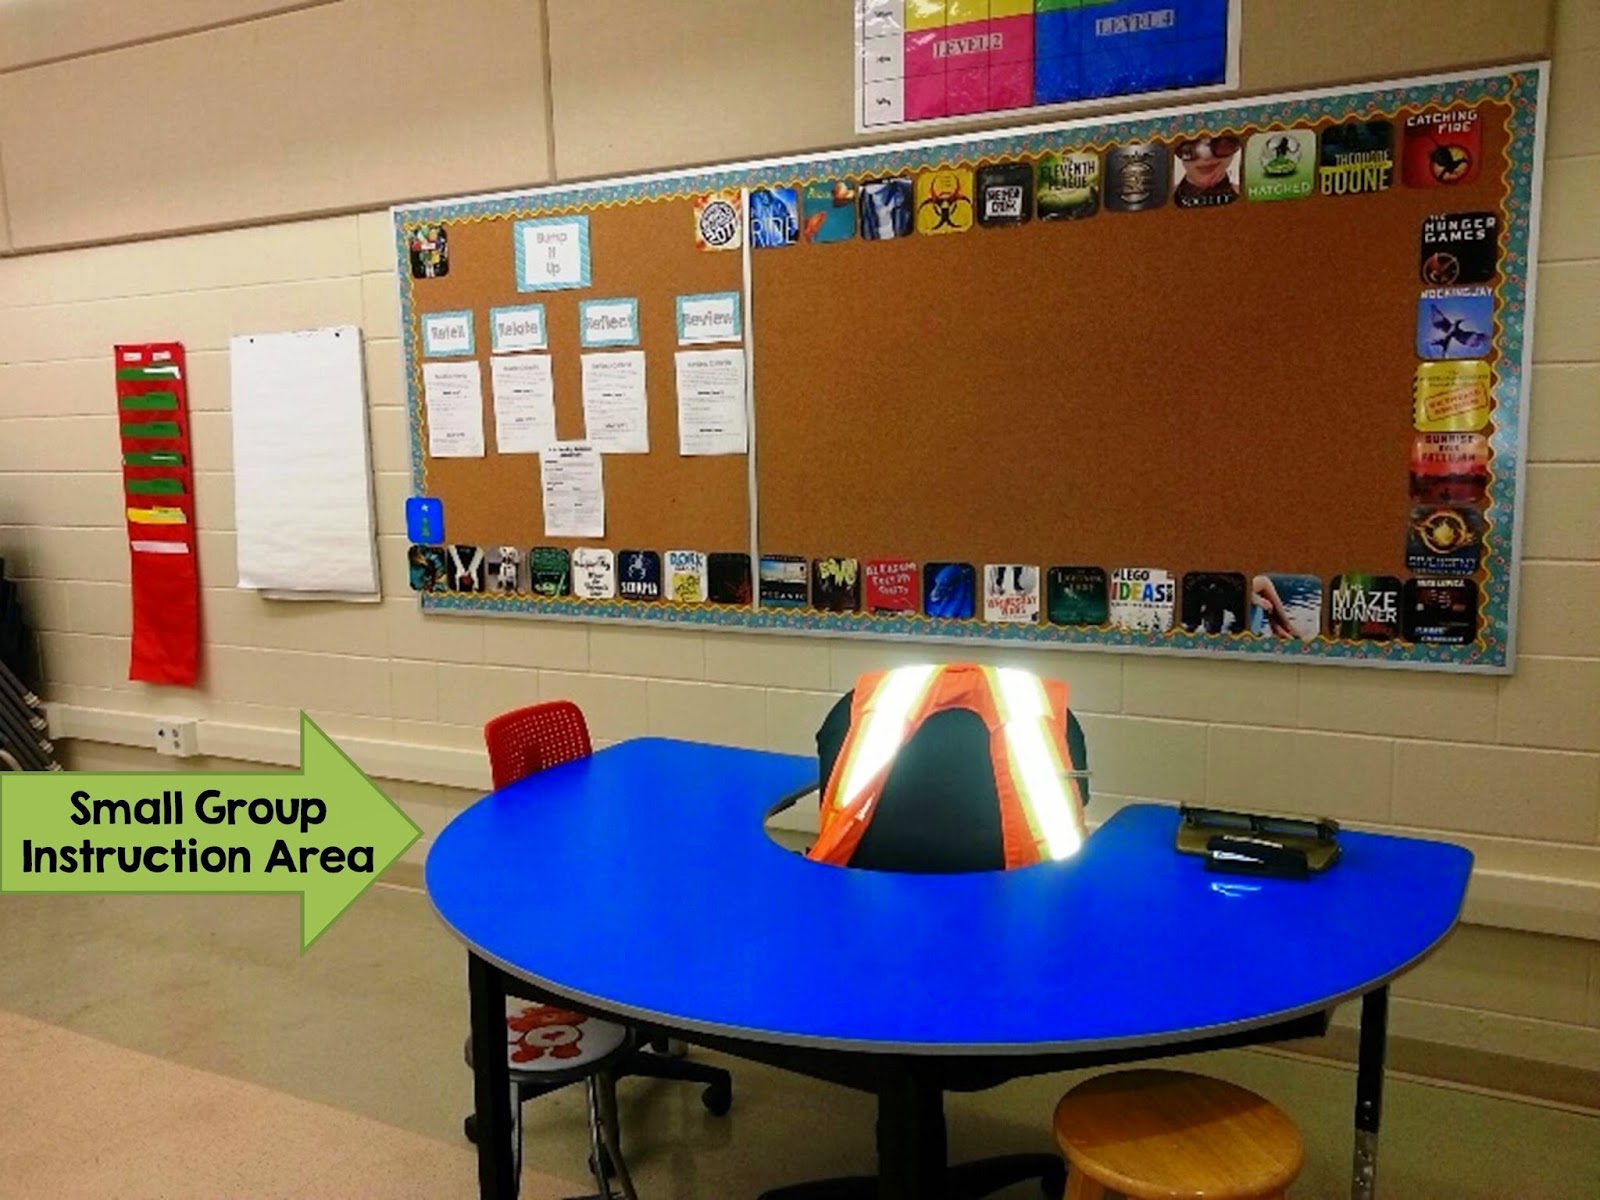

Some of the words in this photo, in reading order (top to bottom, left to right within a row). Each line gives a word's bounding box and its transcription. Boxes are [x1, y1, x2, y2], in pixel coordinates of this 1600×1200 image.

[1407, 110, 1477, 127] CATCHING
[1438, 121, 1471, 134] FIRE
[1320, 167, 1389, 195] BOONE
[1425, 217, 1496, 232] HUNGER
[1425, 229, 1485, 243] GAMES
[546, 262, 561, 277] Up
[1421, 286, 1492, 299] MOCKINGJAY
[682, 311, 733, 327] Review
[1120, 570, 1149, 581] LEGO
[1111, 582, 1165, 601] IDEAS
[1333, 590, 1397, 610] MAZE
[1333, 608, 1397, 623] RUNNER
